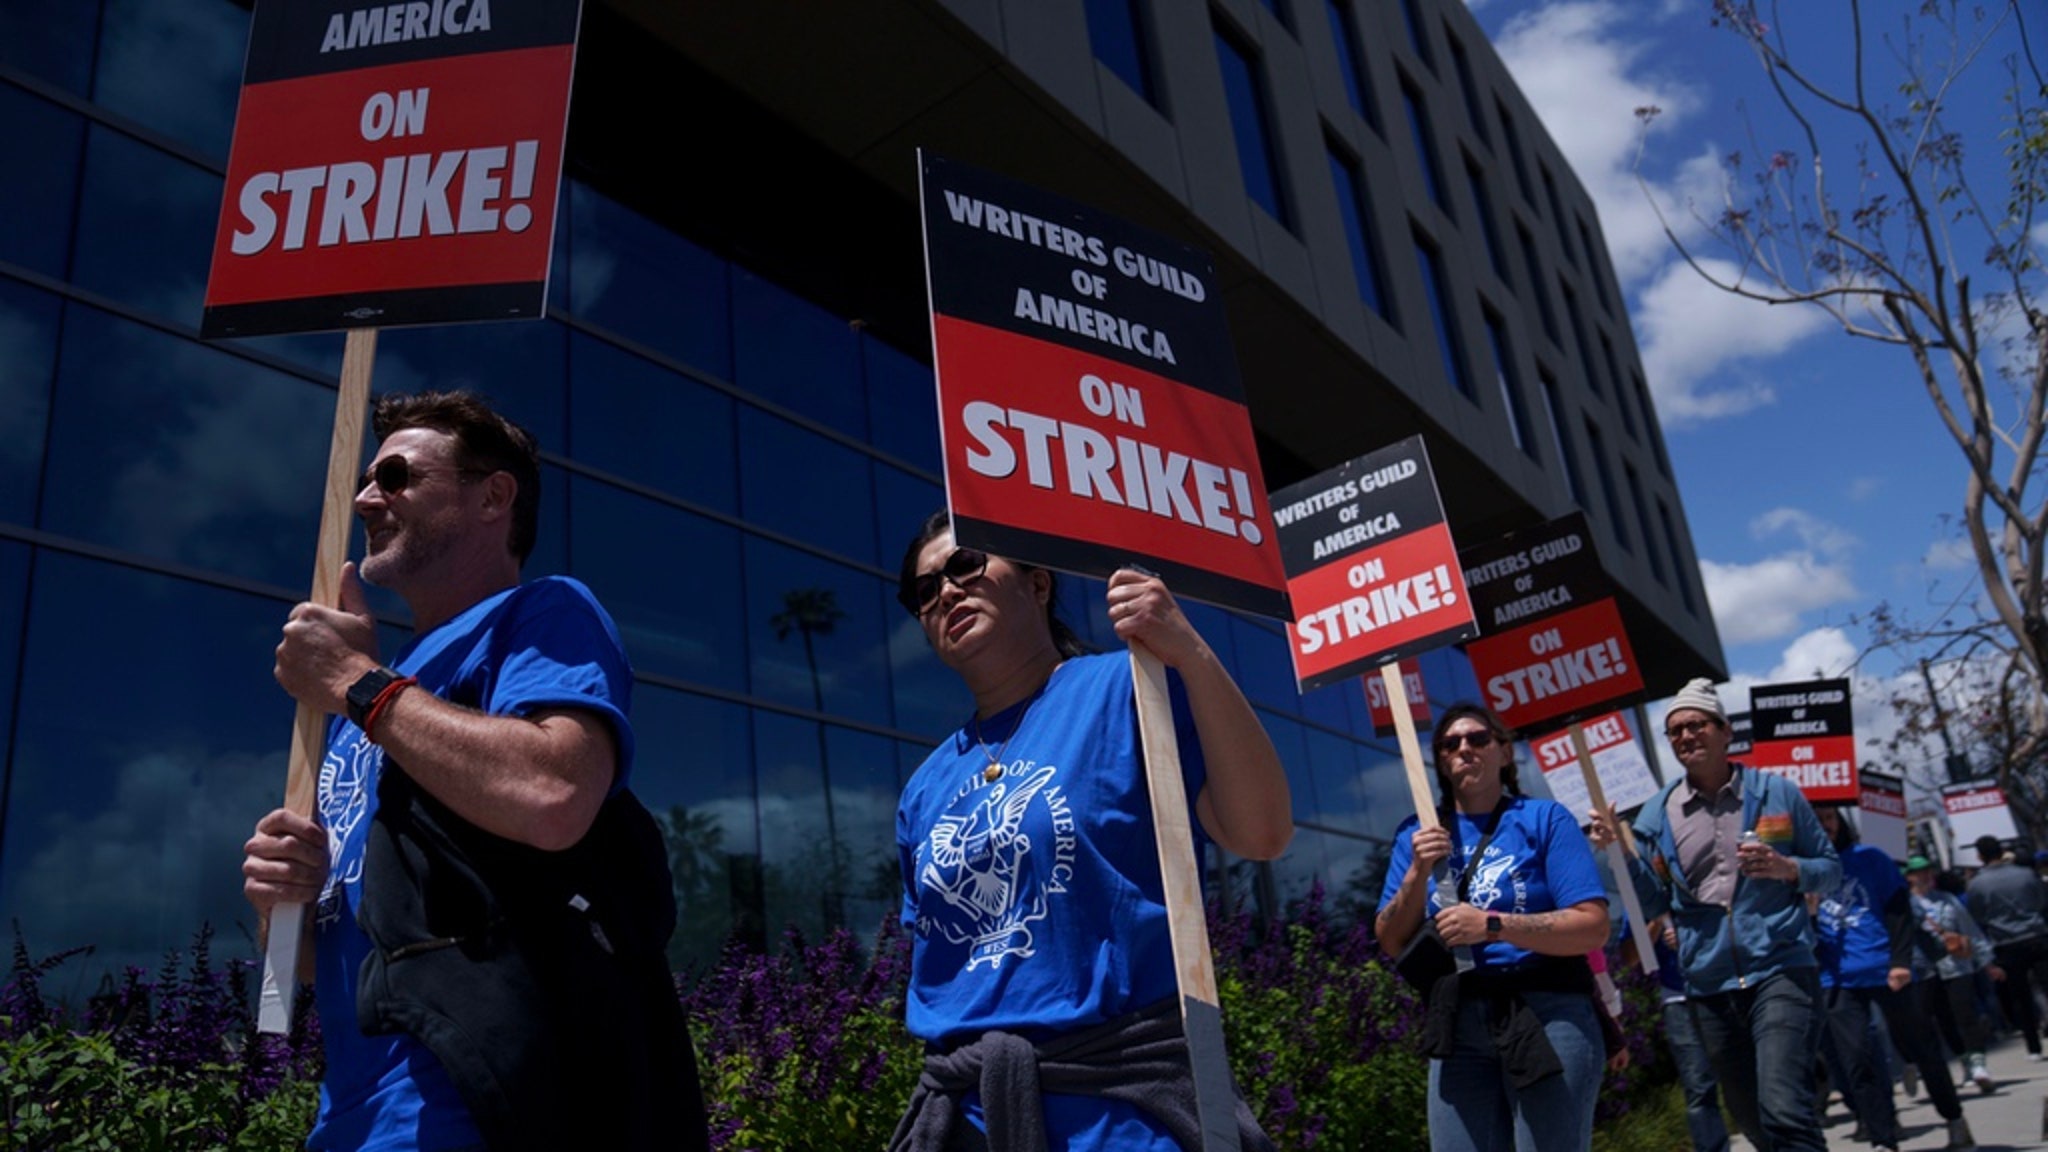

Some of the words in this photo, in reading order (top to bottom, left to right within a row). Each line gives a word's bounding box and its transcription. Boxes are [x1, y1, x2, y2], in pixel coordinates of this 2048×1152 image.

[320, 0, 491, 53] AMERICA
[360, 88, 430, 141] ON
[231, 140, 539, 256] STRIKE!
[944, 189, 1108, 267] WRITERS
[1113, 246, 1205, 302] GUILD
[1071, 269, 1106, 300] OF
[1014, 288, 1176, 365] AMERICA
[1079, 375, 1146, 427] ON
[962, 401, 1264, 546] STRIKE!
[1273, 480, 1359, 528] WRITERS
[1359, 459, 1417, 493] GUILD
[1313, 512, 1401, 560] AMERICA
[1338, 504, 1360, 523] OF
[1347, 558, 1386, 589] ON
[1531, 534, 1582, 564] GUILD
[1494, 585, 1572, 625] AMERICA
[1514, 574, 1533, 592] OF
[1296, 564, 1458, 655] STRIKE!
[1529, 627, 1563, 656] ON
[1487, 637, 1627, 712] STRIKE!
[1808, 690, 1844, 705] GUILD
[1774, 720, 1828, 736] AMERICA
[1791, 746, 1814, 760] ON
[1009, 759, 1037, 776] OF
[1043, 785, 1076, 893] AMERICA
